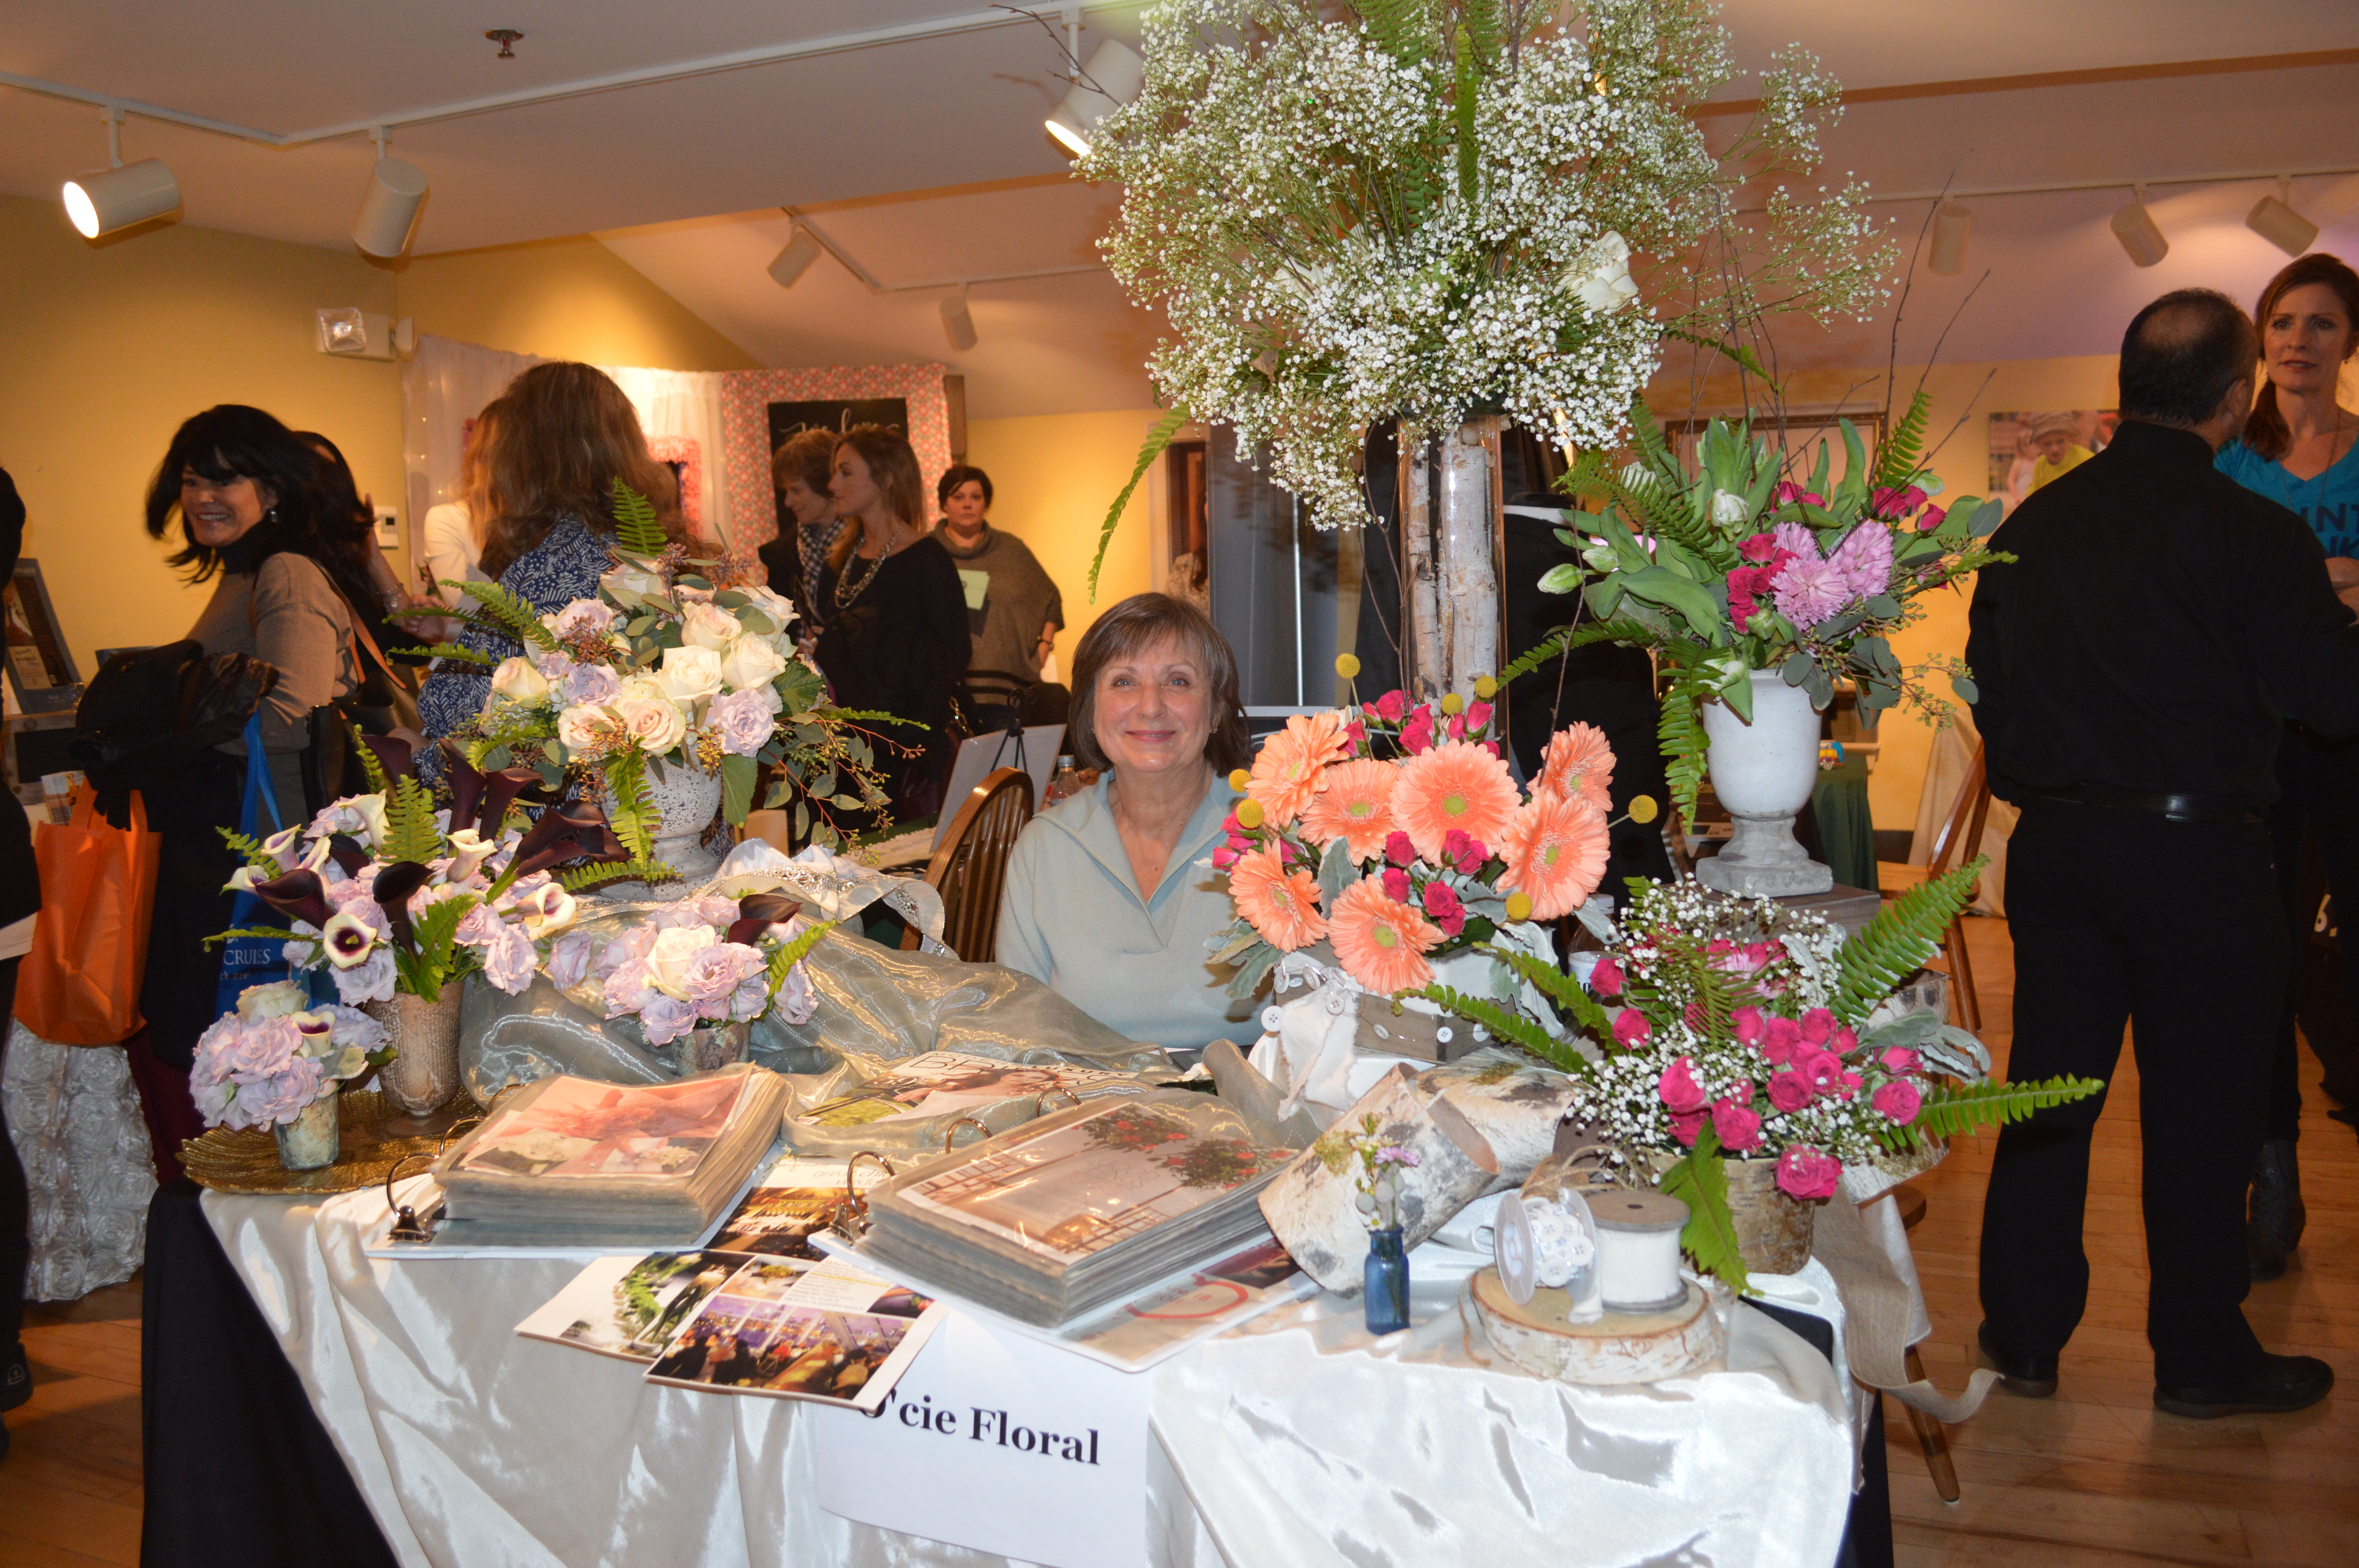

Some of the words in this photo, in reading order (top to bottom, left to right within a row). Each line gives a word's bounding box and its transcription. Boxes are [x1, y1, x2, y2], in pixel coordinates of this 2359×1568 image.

[932, 1053, 1024, 1067] MODERN
[1032, 1065, 1129, 1076] LUXURY
[969, 1406, 1100, 1465] Floral
